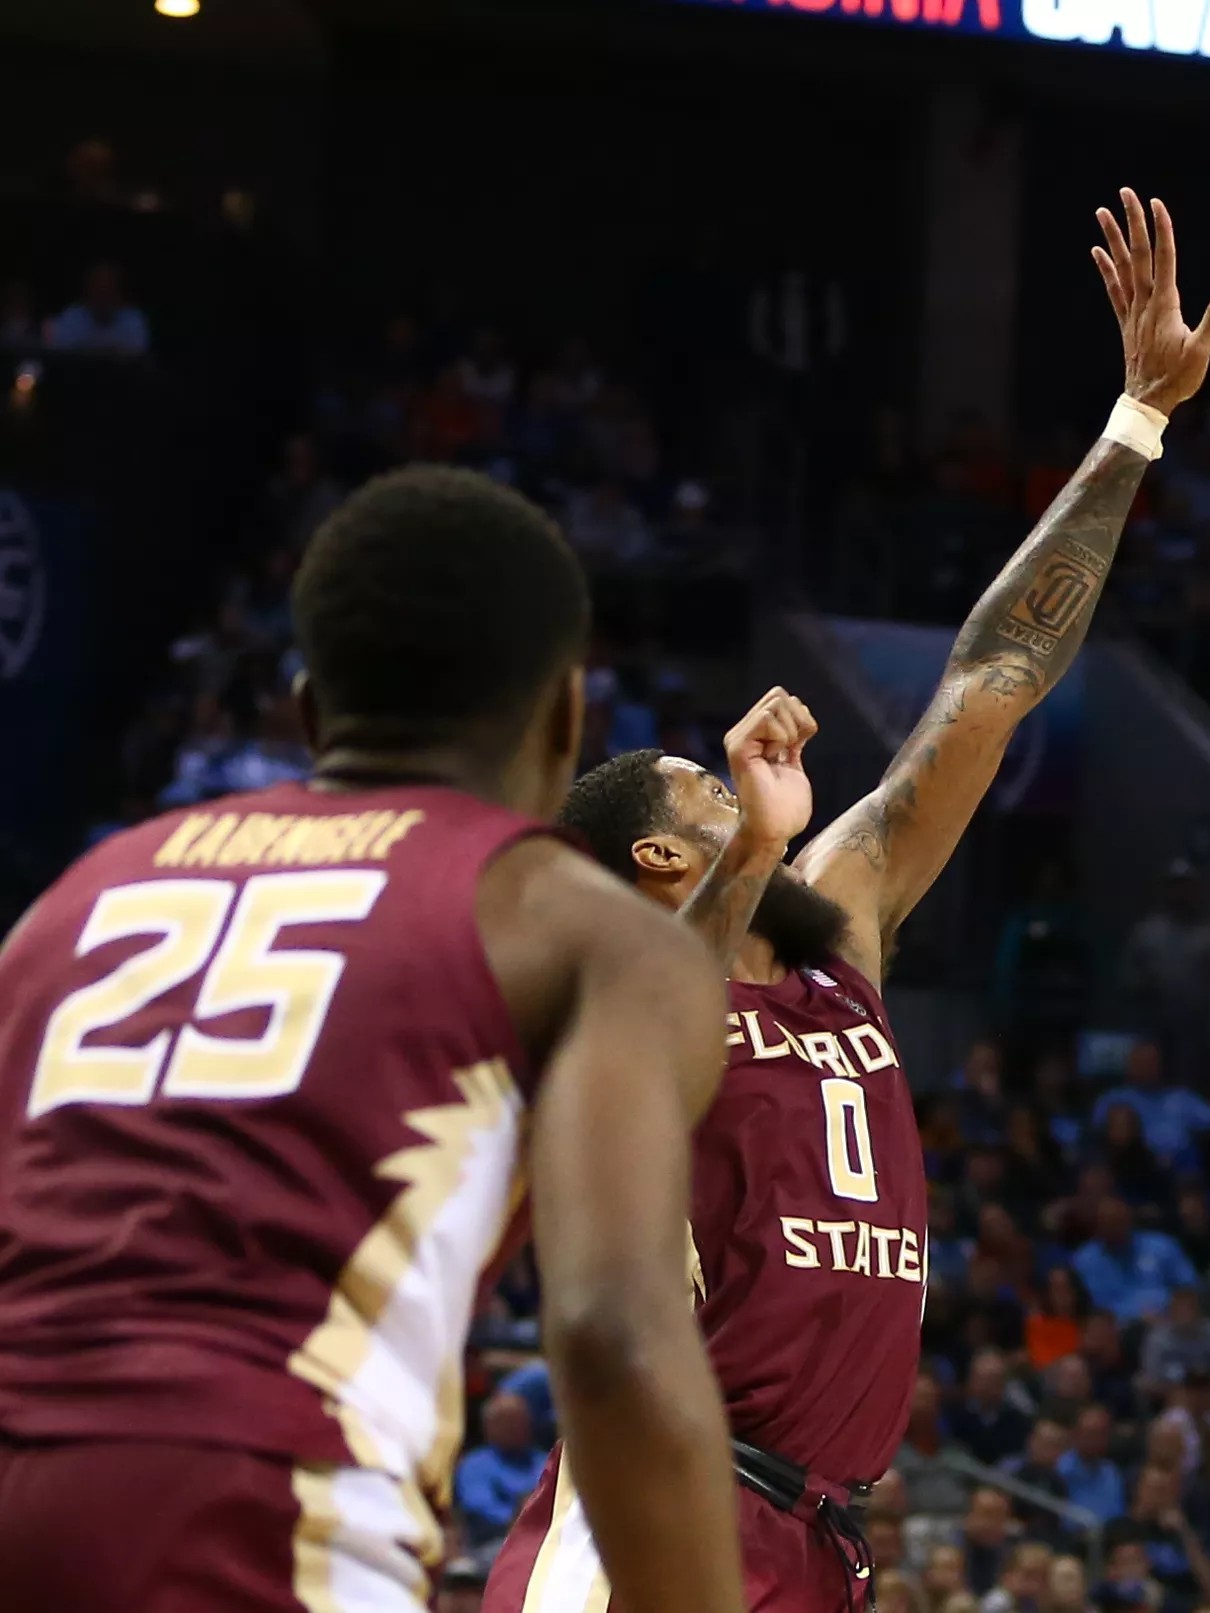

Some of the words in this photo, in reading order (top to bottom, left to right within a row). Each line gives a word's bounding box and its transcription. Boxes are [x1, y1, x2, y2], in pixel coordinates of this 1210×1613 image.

[27, 868, 389, 1121] 25
[726, 1010, 900, 1078] FLRID
[821, 1078, 878, 1202] 0
[780, 1216, 922, 1283] STATE
